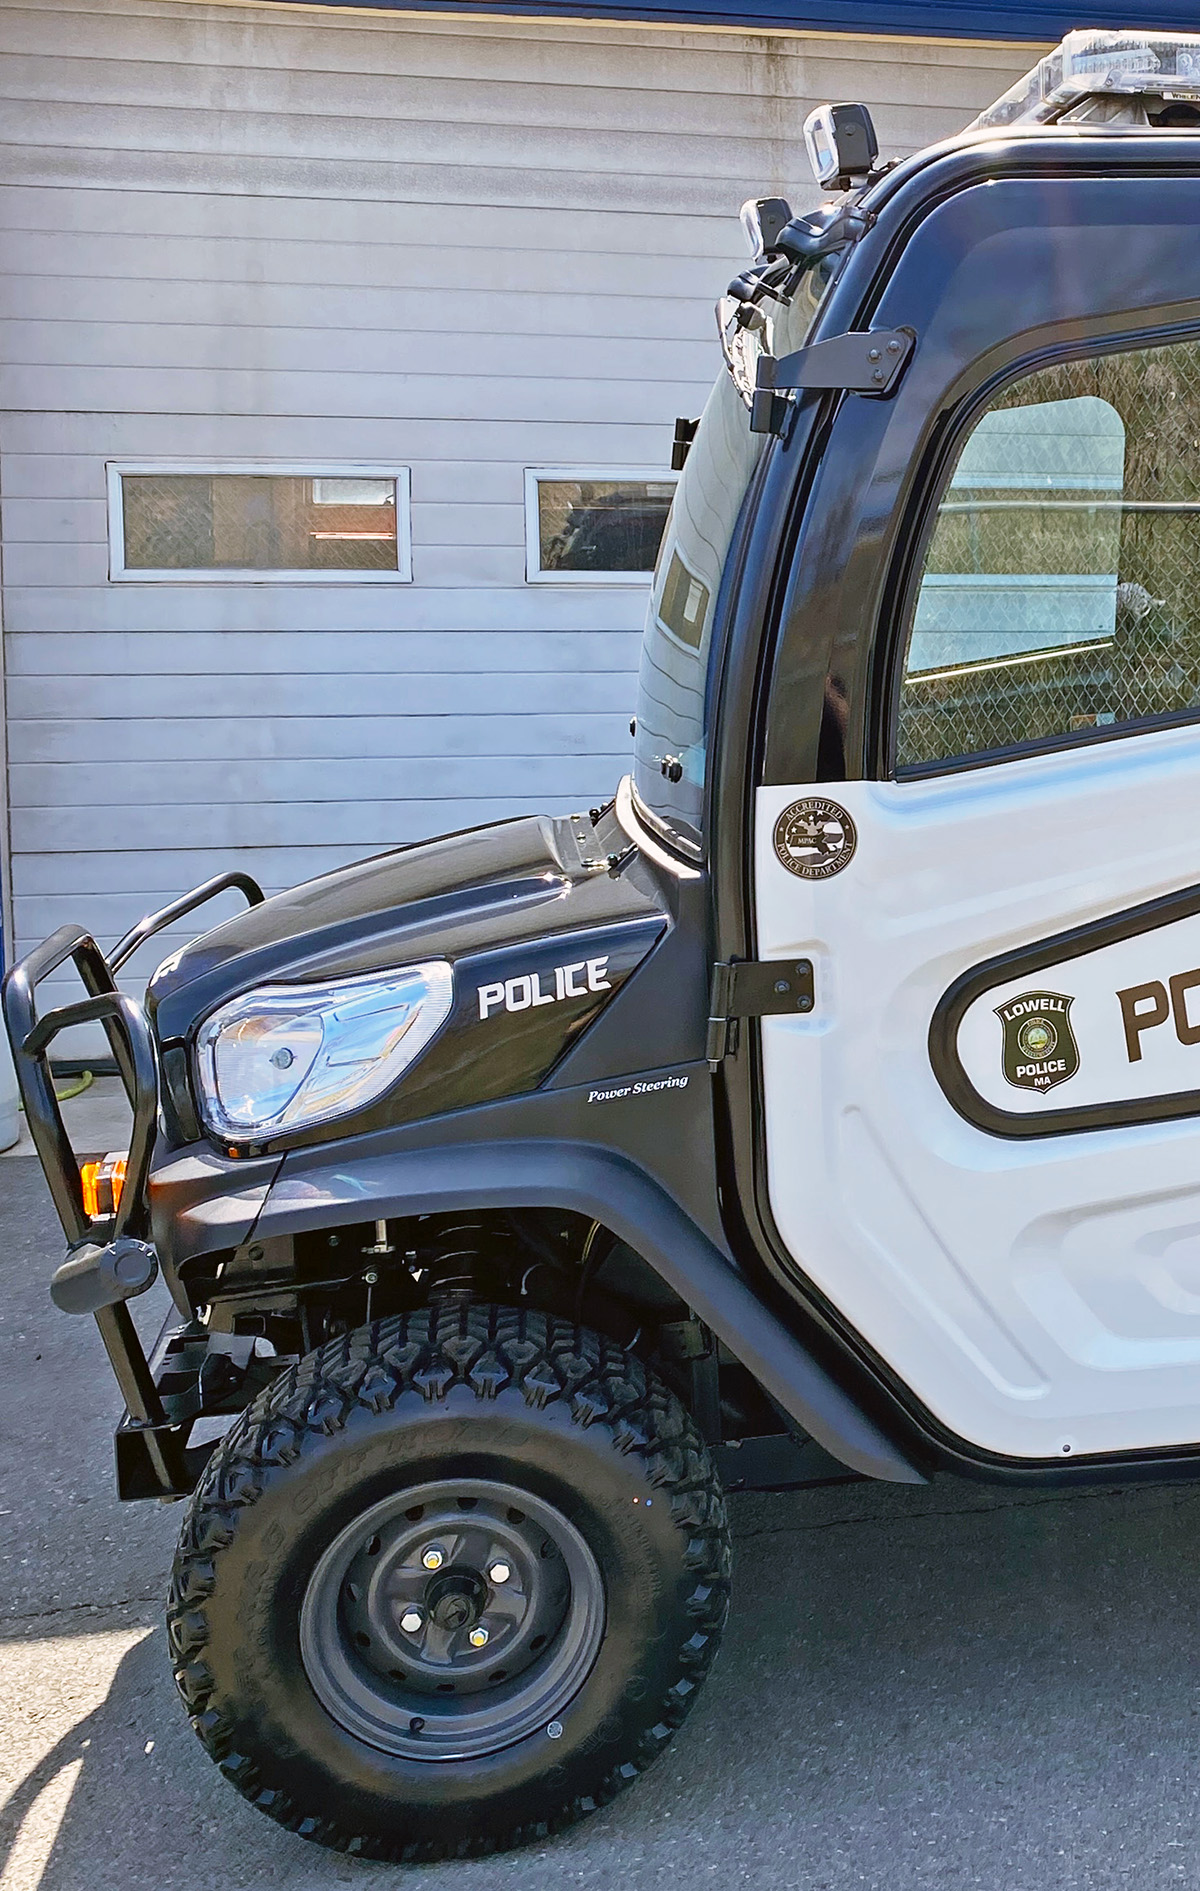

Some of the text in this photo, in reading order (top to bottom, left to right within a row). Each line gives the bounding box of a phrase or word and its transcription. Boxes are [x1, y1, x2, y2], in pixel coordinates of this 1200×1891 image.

[785, 801, 844, 821] ACCREDITED
[777, 841, 853, 876] POLICE DEPARTMENT
[476, 954, 613, 1021] POLICE
[1003, 998, 1066, 1021] LOWELL
[1016, 1058, 1067, 1078] POLICE
[587, 1076, 689, 1103] Power Steering
[1034, 1076, 1052, 1086] MA
